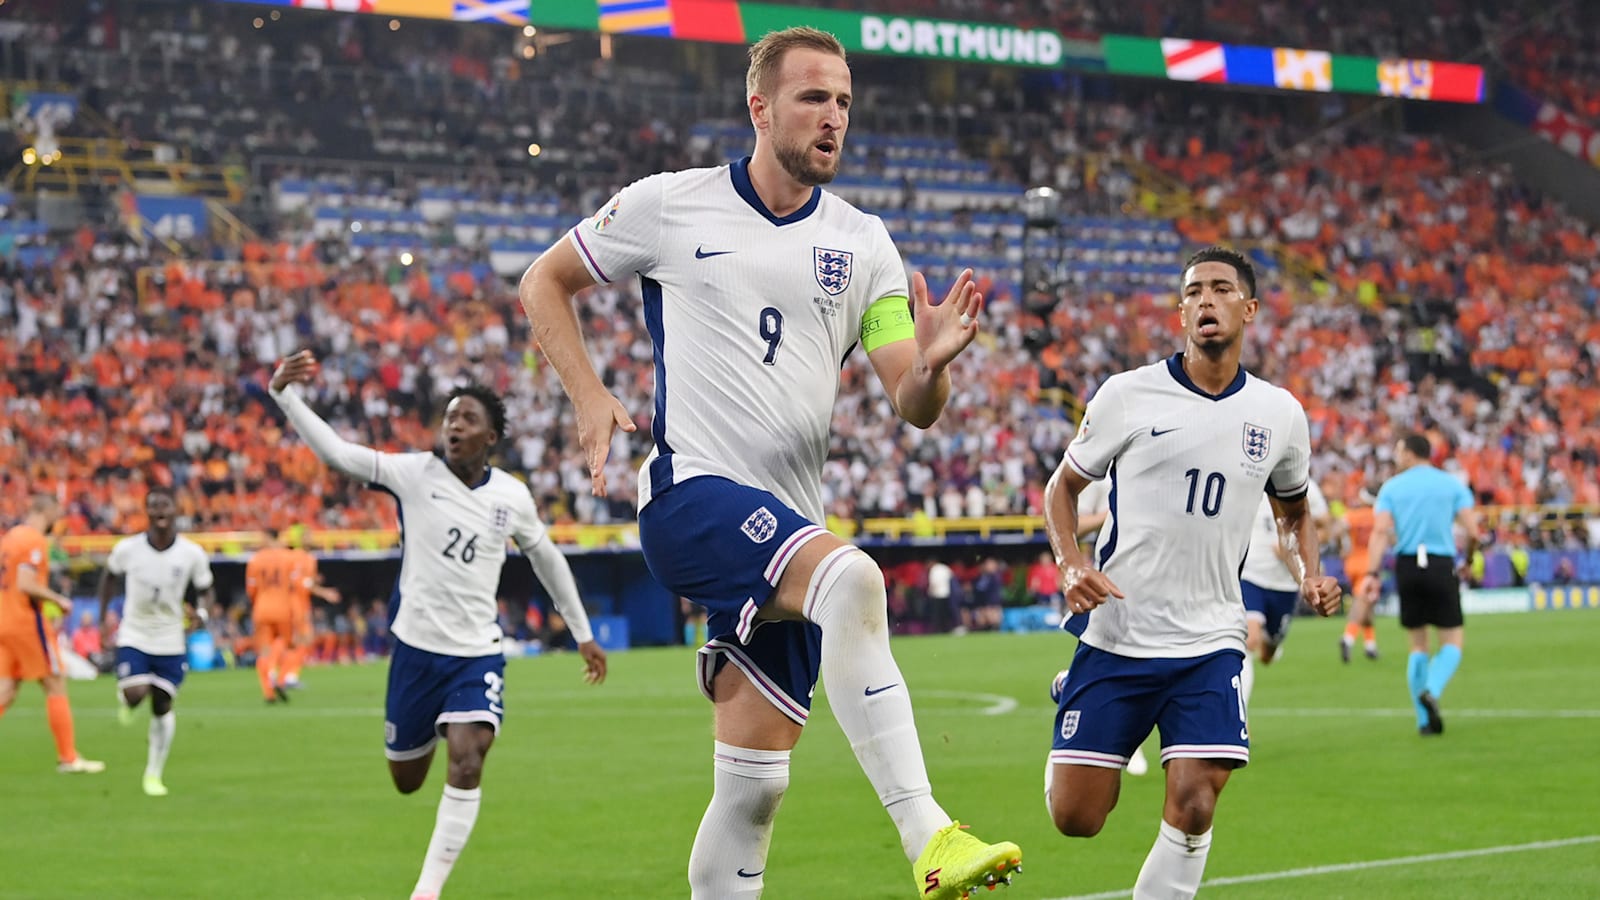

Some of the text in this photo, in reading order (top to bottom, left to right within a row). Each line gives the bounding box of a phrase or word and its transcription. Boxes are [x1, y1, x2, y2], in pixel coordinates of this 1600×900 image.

[861, 16, 1062, 65] DORTMUND
[760, 307, 784, 366] 9
[1184, 467, 1227, 518] 10
[442, 527, 479, 564] 26
